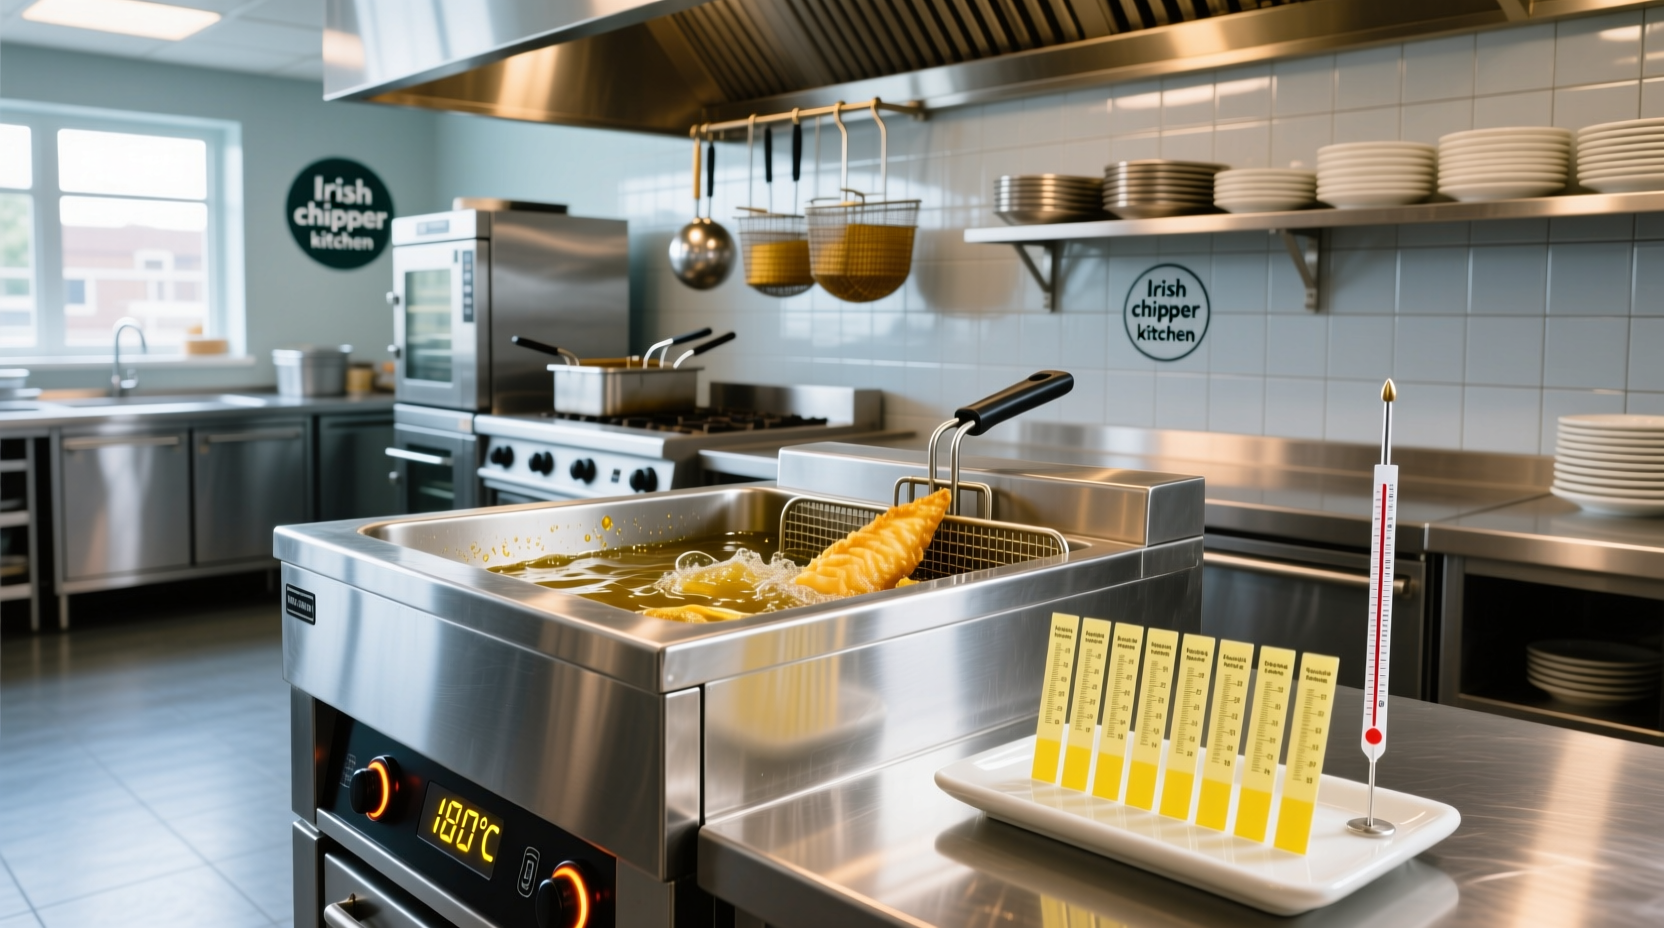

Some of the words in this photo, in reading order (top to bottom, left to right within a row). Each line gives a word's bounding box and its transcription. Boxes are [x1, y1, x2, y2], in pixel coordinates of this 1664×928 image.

[314, 175, 373, 205] Irish
[293, 201, 388, 233] chipper
[310, 230, 374, 251] kitchen
[1147, 278, 1186, 297] Irish
[1131, 298, 1200, 323] chipper
[1137, 323, 1195, 342] kitchen
[432, 797, 500, 863] 180°C
